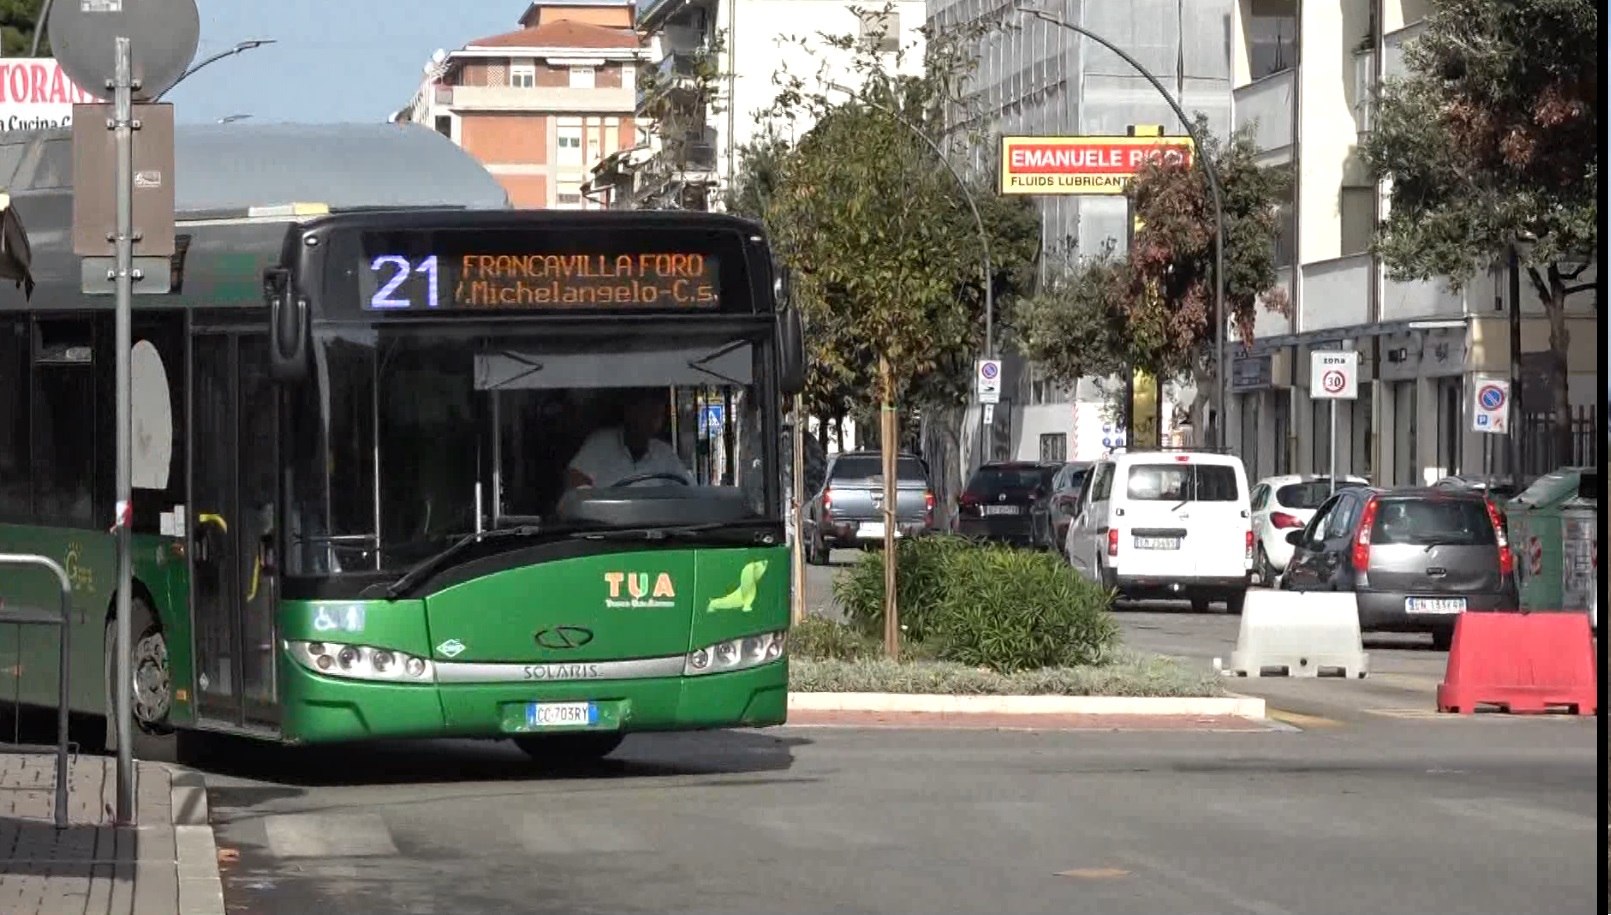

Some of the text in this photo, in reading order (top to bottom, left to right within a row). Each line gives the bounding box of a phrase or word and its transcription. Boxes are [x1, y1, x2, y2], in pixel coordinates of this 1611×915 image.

[1011, 150, 1122, 167] EMANUELE
[1011, 176, 1054, 187] FLUIDS
[463, 253, 704, 278] FRANCAVILLA FORO
[371, 254, 438, 308] 21
[1323, 357, 1346, 365] zona
[1328, 376, 1341, 388] 30
[604, 571, 675, 598] TUA
[523, 665, 598, 679] SOLARIS
